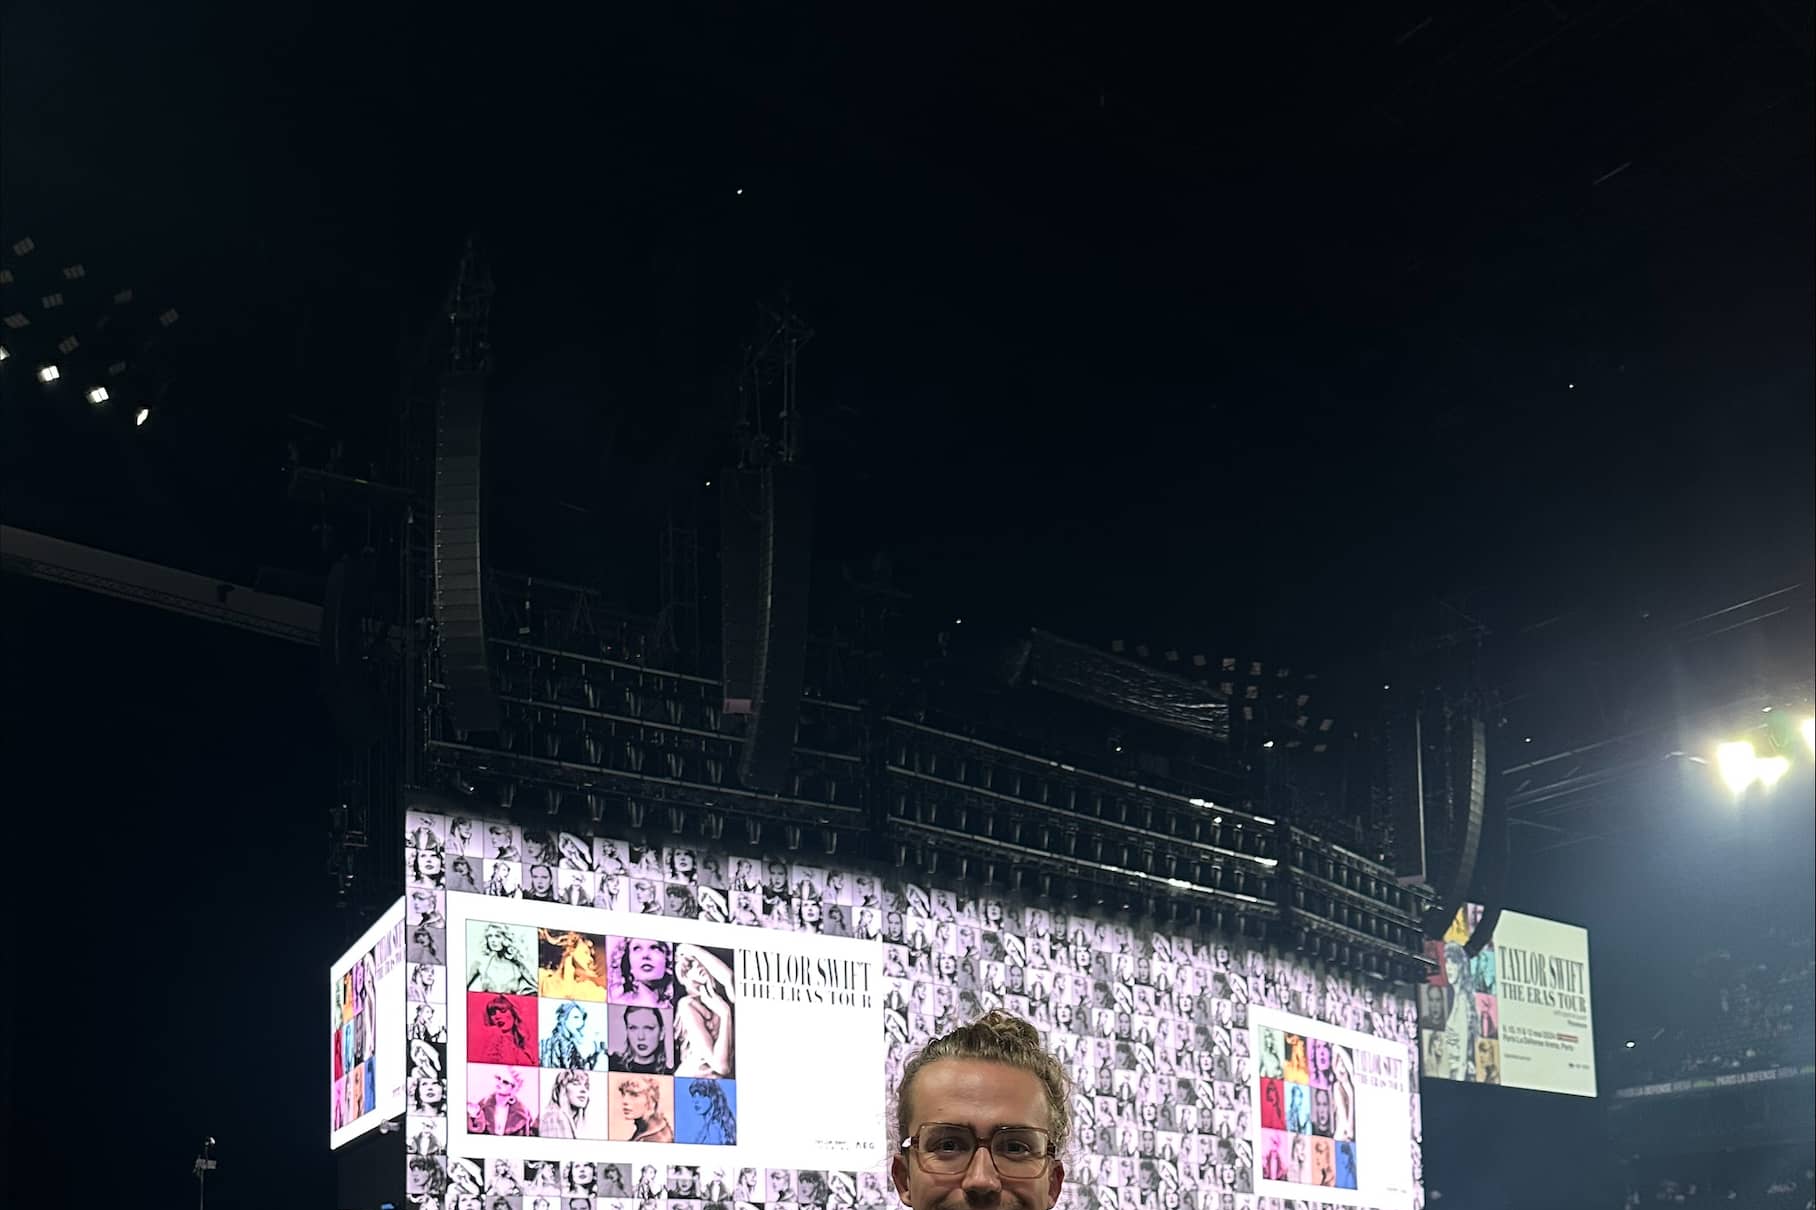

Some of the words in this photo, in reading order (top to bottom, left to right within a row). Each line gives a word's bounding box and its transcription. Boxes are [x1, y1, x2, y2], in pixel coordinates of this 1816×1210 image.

[739, 948, 812, 986] TAYLOR
[817, 957, 872, 992] SWIFT
[1499, 945, 1548, 988] TAYLOR
[1549, 954, 1584, 995] SWIFT
[739, 982, 776, 1000] THE
[780, 985, 824, 1003] ERAS
[828, 990, 872, 1009] TOUR
[1501, 982, 1525, 1002] THE
[1527, 986, 1556, 1008] ERAS
[1557, 992, 1587, 1014] TOUR
